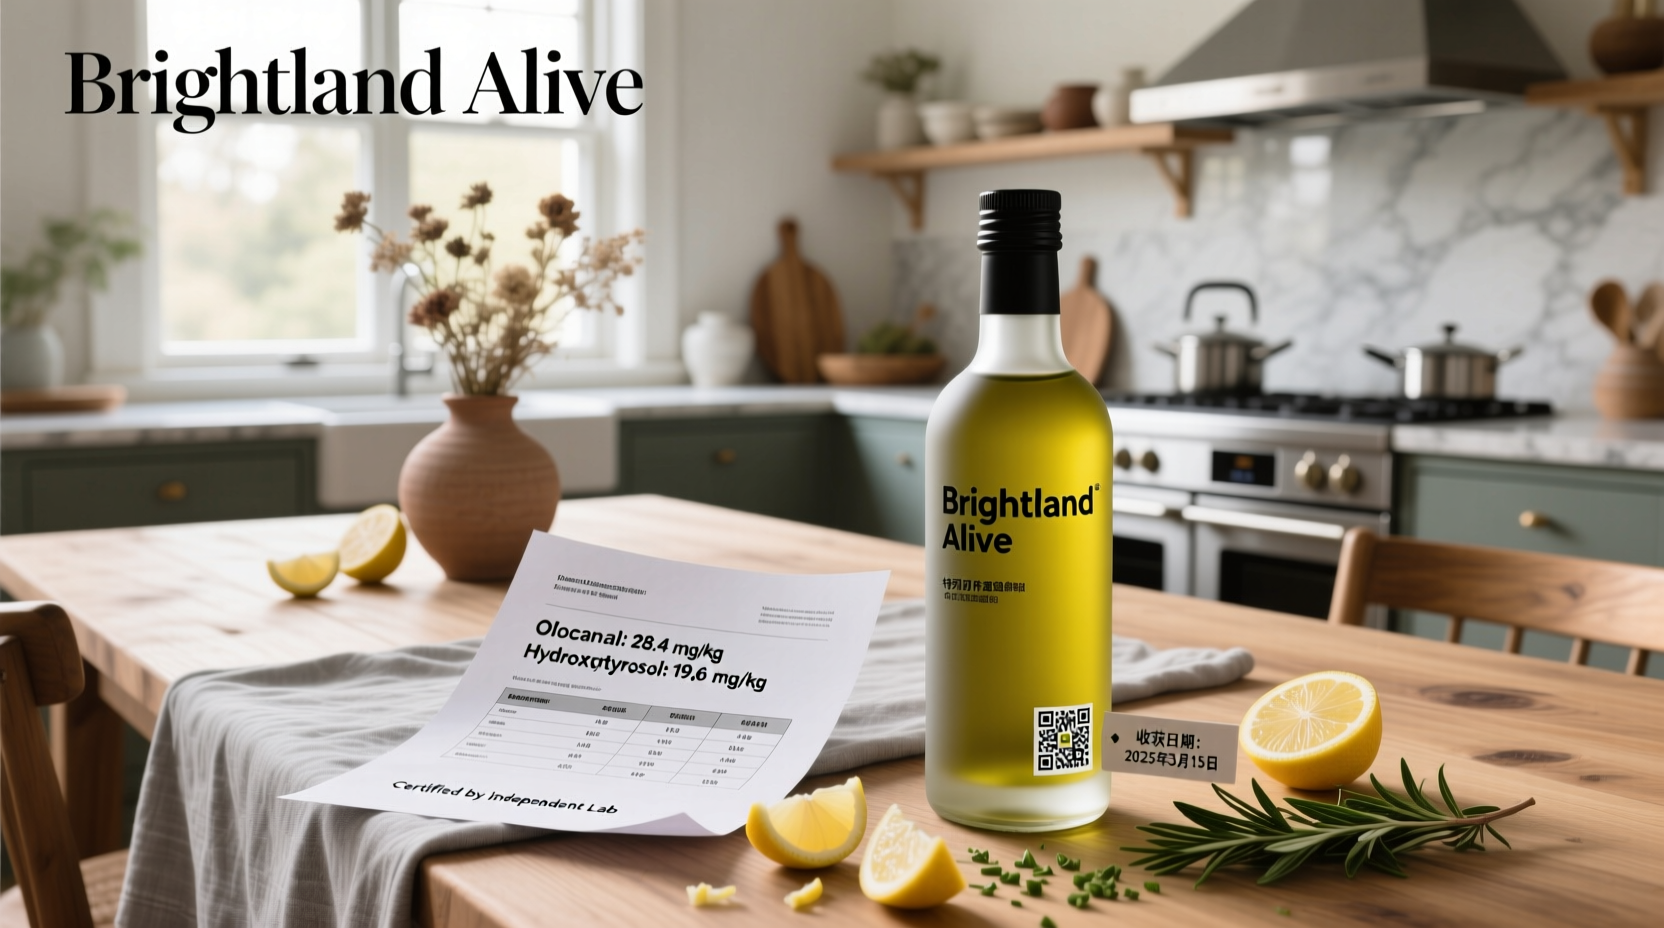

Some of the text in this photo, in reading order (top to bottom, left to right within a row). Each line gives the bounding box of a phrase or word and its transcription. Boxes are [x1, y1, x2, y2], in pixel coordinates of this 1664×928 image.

[942, 484, 1095, 526] Brightland
[942, 522, 1013, 555] Alive
[630, 633, 670, 653] 28.4
[672, 641, 725, 664] mg/kg
[711, 671, 768, 693] mg/kg
[392, 780, 464, 797] Certified
[465, 790, 486, 801] by
[587, 803, 619, 815] Lab
